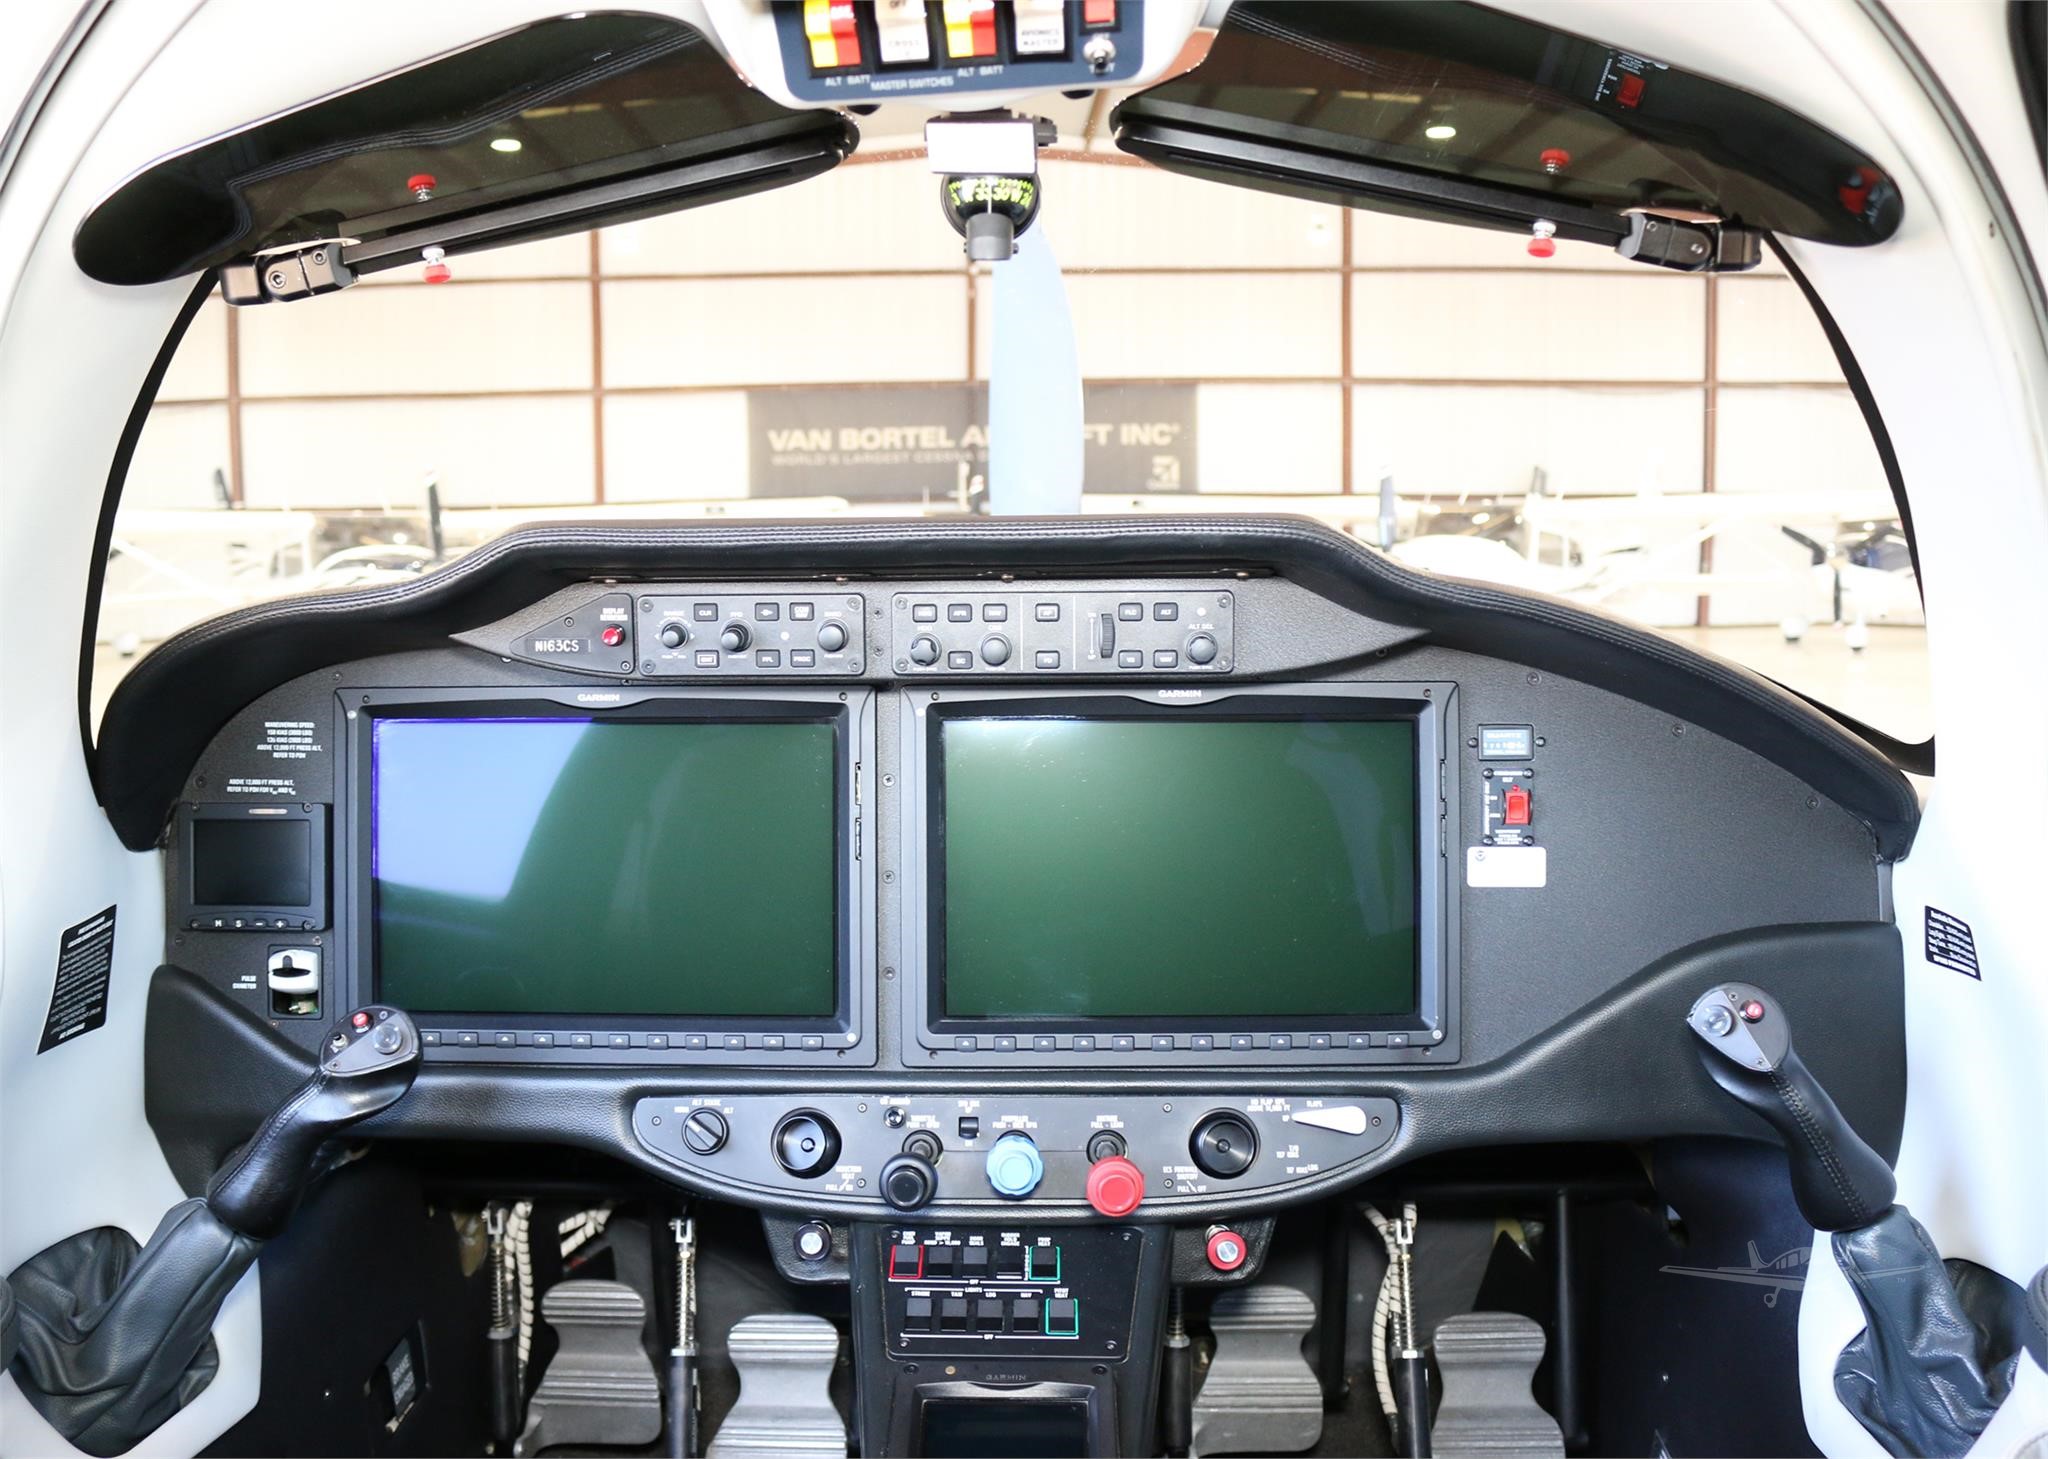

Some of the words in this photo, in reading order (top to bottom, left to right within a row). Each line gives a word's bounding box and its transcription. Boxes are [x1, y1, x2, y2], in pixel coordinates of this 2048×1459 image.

[958, 67, 974, 78] ALT
[980, 65, 1004, 76] BATT
[825, 77, 842, 87] ALT
[847, 74, 870, 85] BATT
[870, 78, 907, 91] MASTER
[908, 76, 954, 89] SWITCHES
[768, 429, 832, 450] VAN
[840, 426, 956, 450] BORTEL
[535, 640, 579, 652] N163CS
[577, 694, 620, 702] GARMIN
[1158, 689, 1202, 698] GARMIN
[235, 920, 242, 928] S
